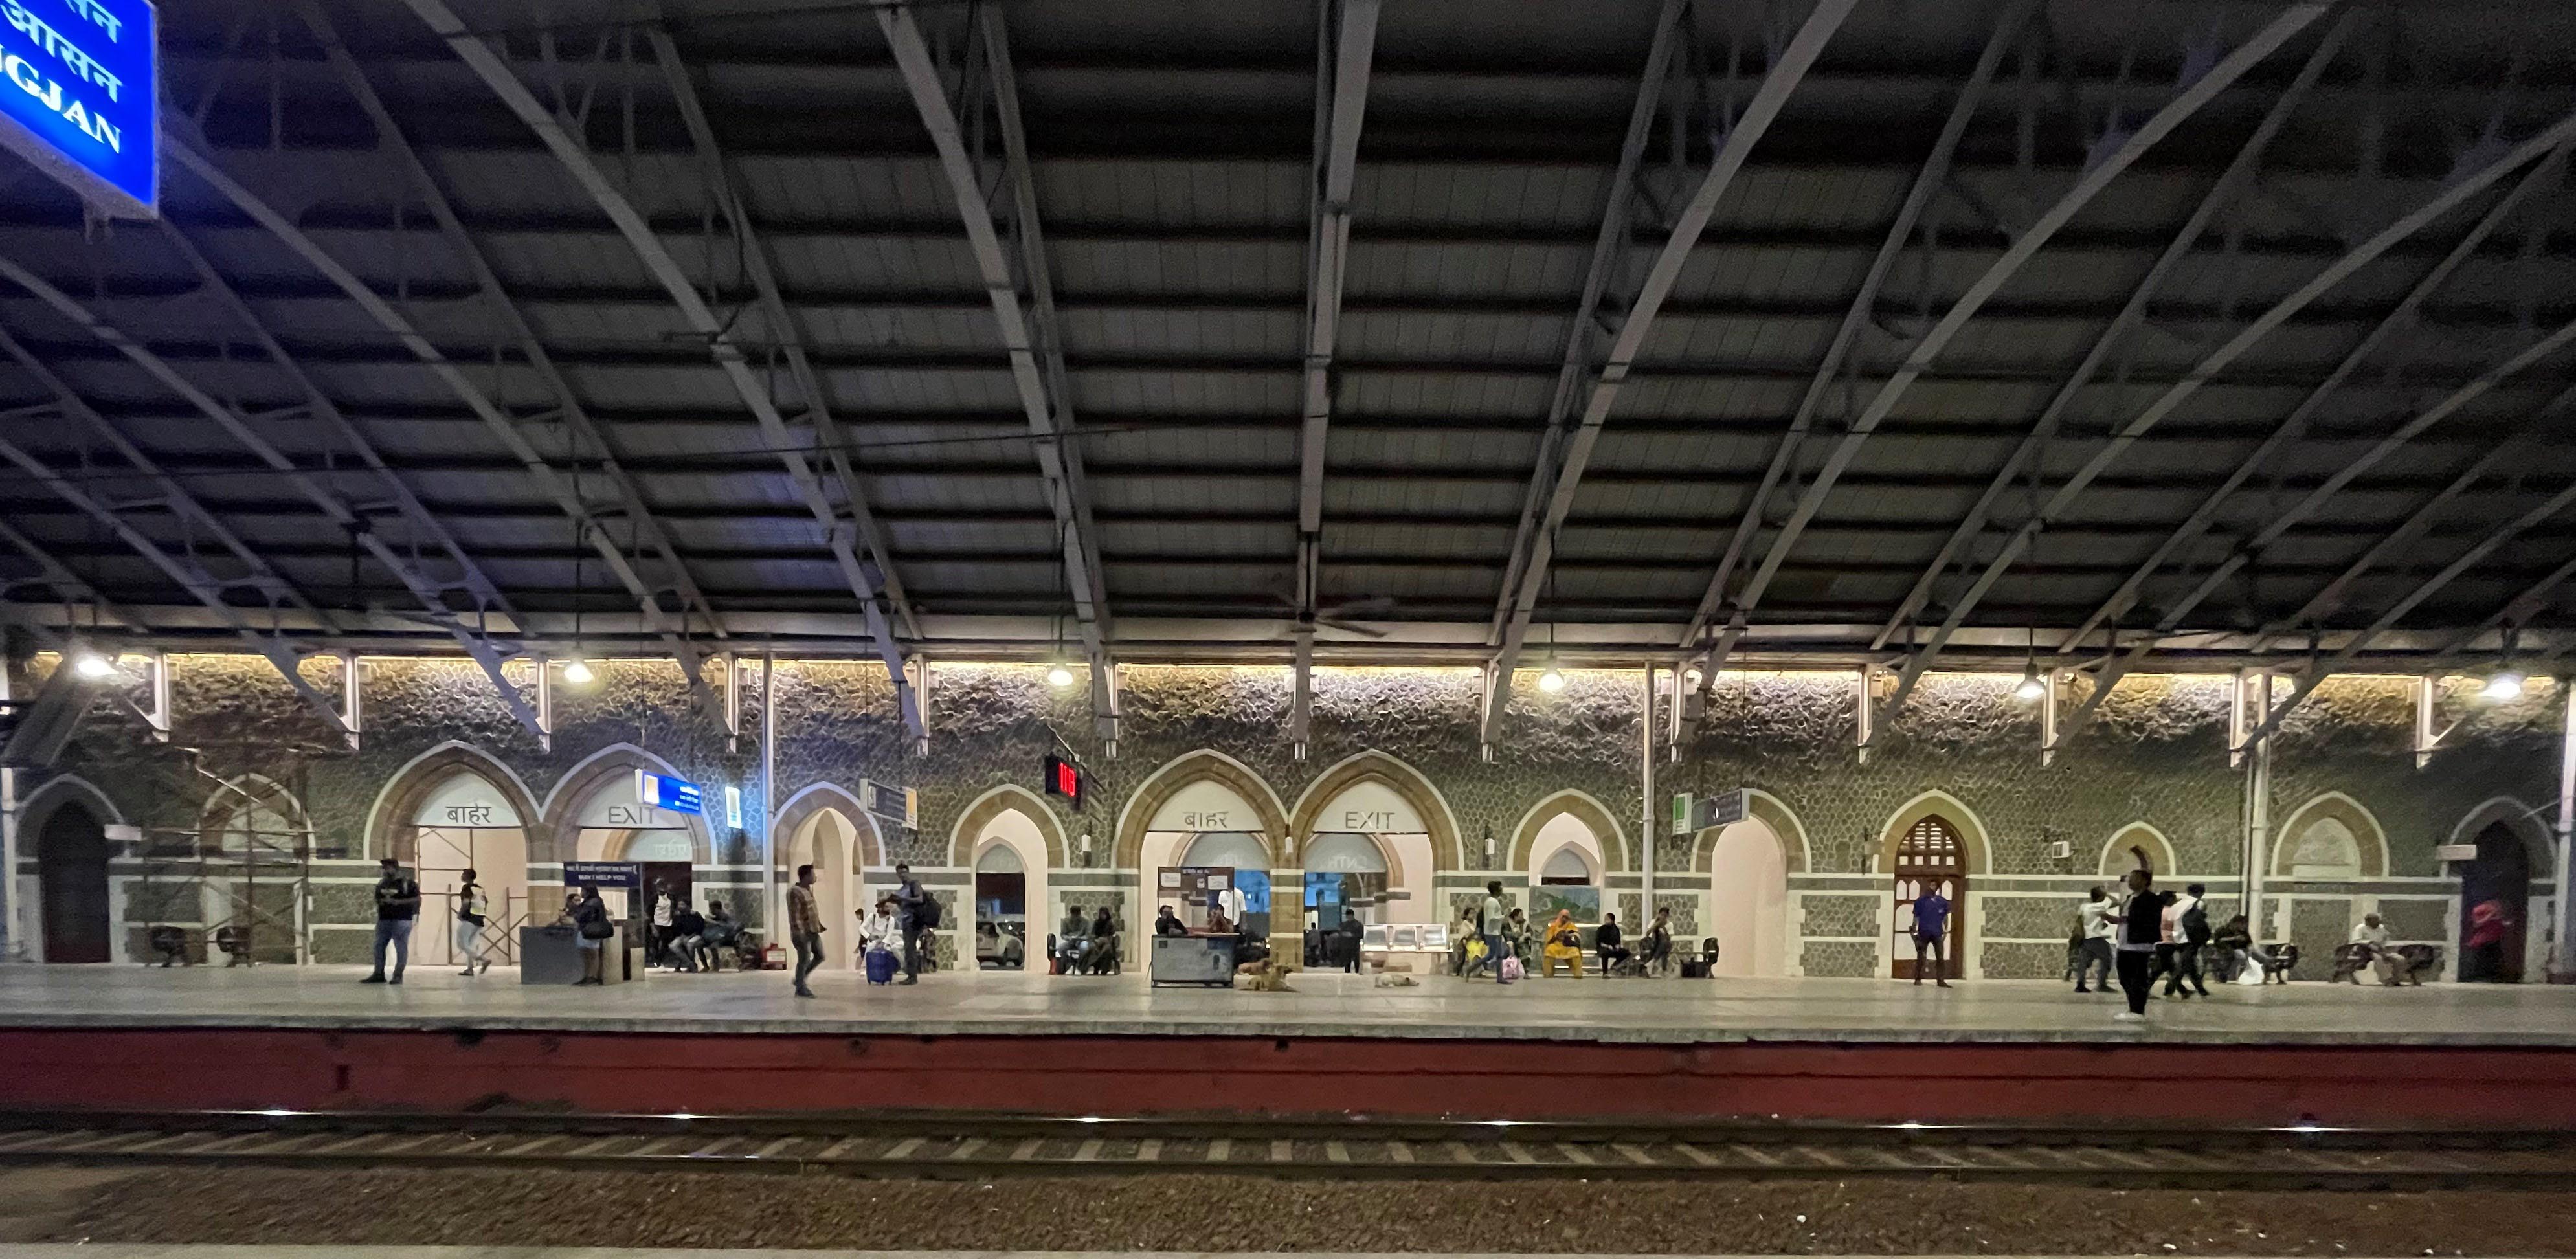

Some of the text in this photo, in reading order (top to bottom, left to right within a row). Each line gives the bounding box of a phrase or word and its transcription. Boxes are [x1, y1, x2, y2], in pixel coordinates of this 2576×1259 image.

[0, 44, 122, 154] GJAN
[608, 806, 653, 824] EXIT
[1183, 811, 1229, 829] बाहर
[1345, 811, 1395, 829] EXIT
